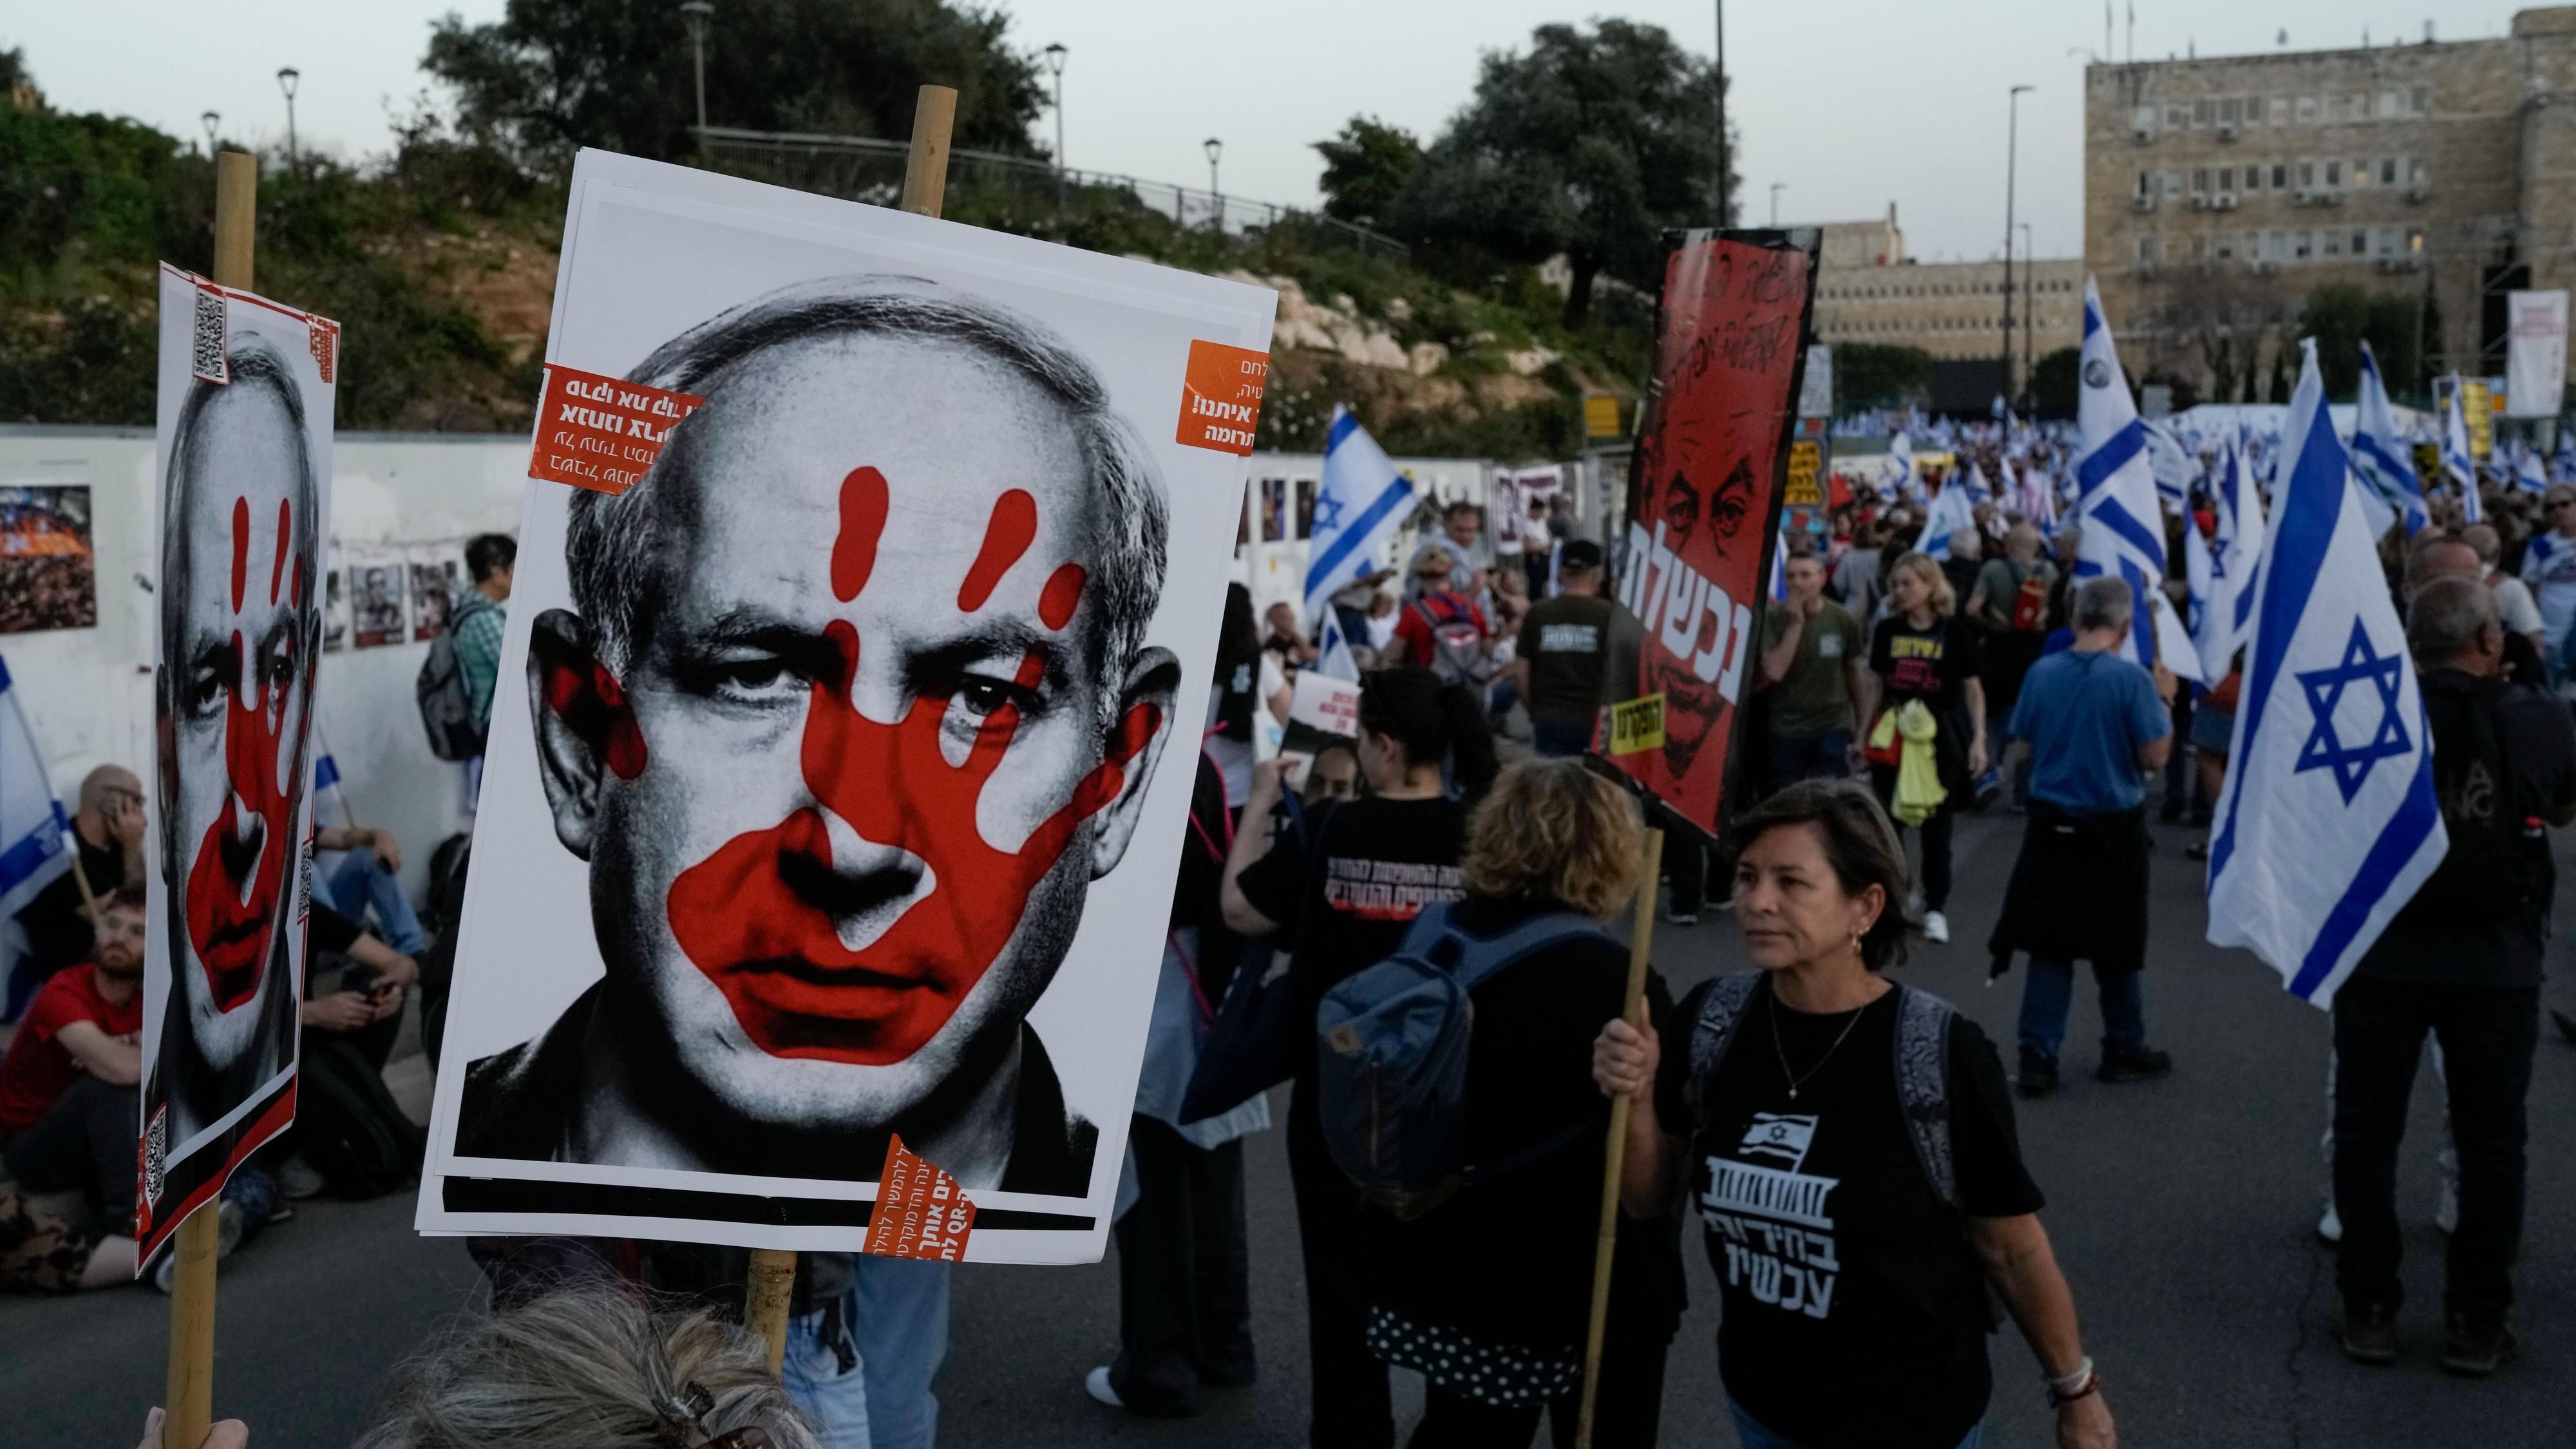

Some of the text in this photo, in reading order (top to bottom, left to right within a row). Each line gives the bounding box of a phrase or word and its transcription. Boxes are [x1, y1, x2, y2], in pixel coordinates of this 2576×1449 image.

[565, 380, 614, 404] סרקו
[617, 390, 650, 412] את
[651, 396, 681, 419] קוד
[1236, 384, 1263, 399] טיה,
[559, 403, 623, 433] אנחנו
[1192, 395, 1252, 423] איתנו!
[554, 431, 574, 451] על
[580, 437, 618, 456] עתיד
[1205, 425, 1255, 448] תרומה
[551, 455, 598, 481] בשביל
[1618, 518, 1752, 706] נכשלת
[884, 1160, 909, 1212] להמשיך
[914, 1159, 931, 1185] ינה
[918, 1204, 945, 1251] אותך
[1703, 1209, 1840, 1273] בחירות
[1725, 1242, 1835, 1320] עכשיו
